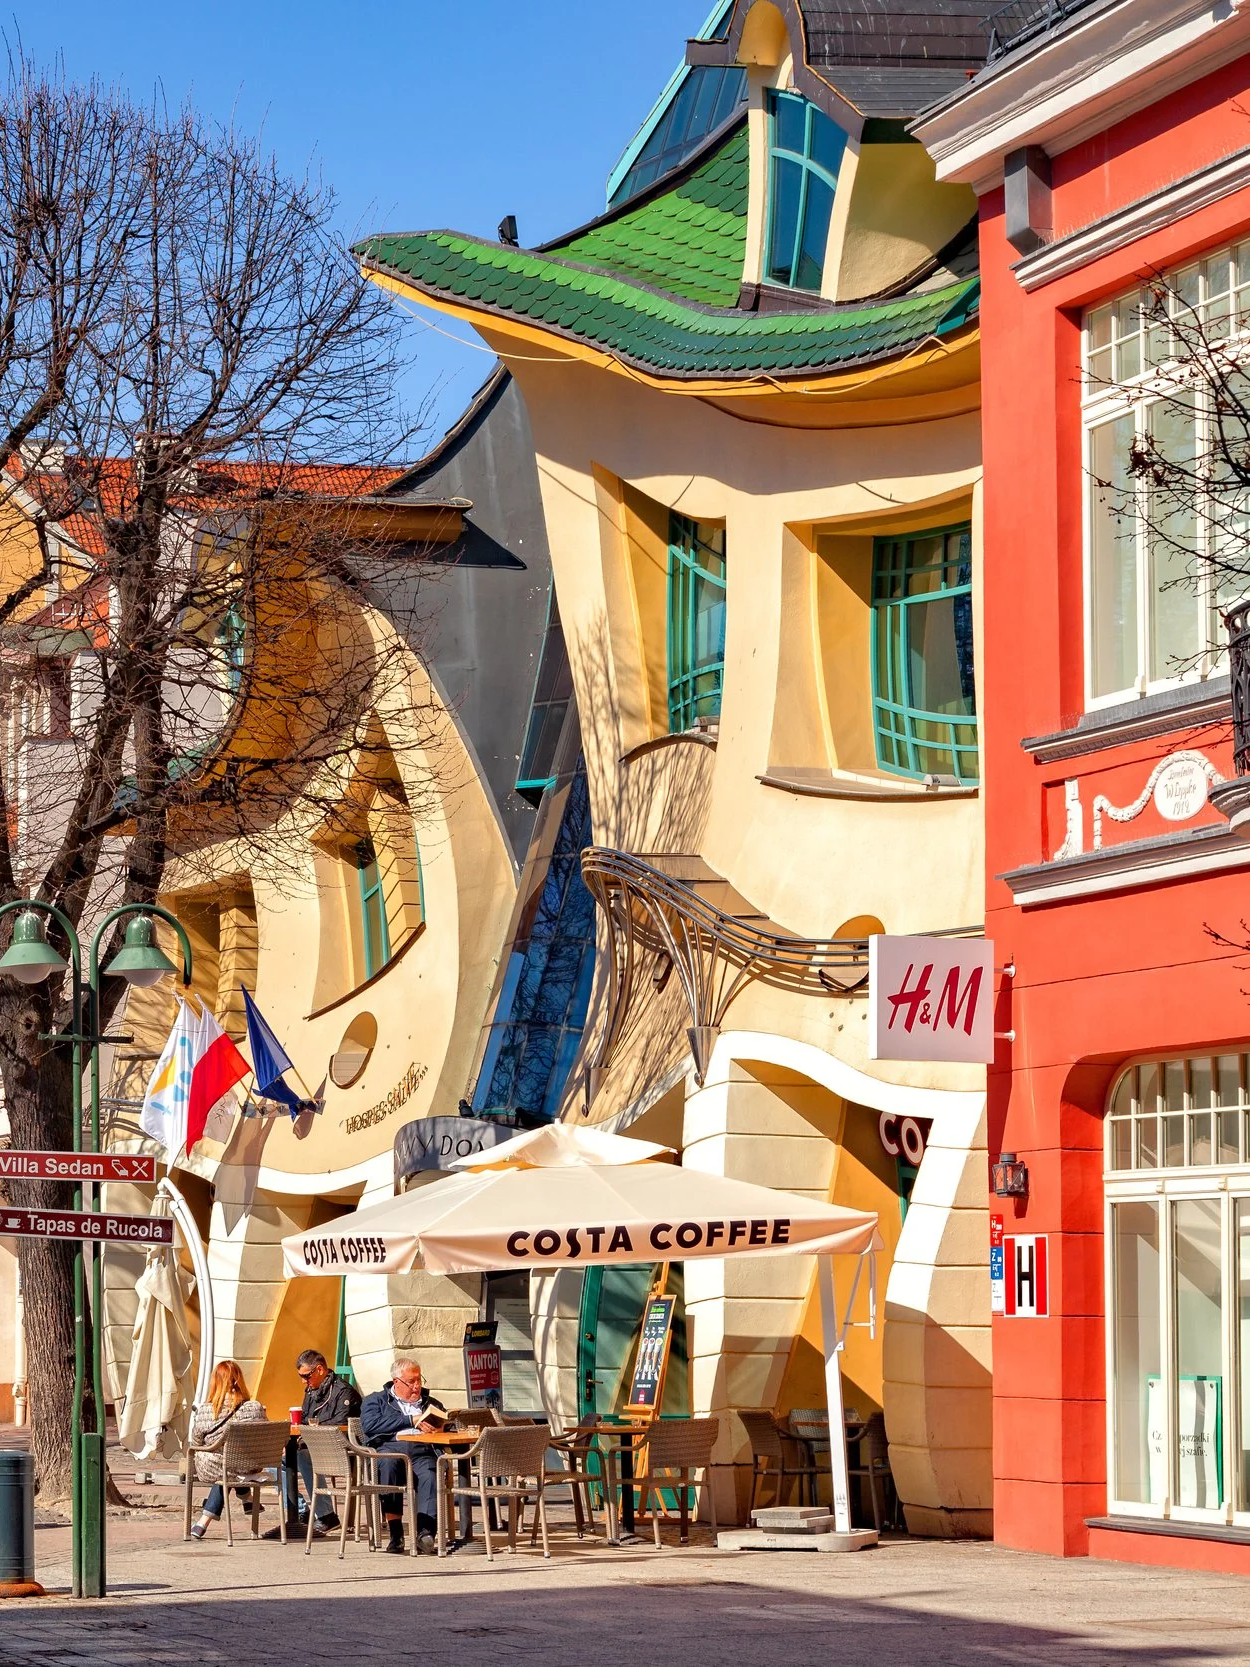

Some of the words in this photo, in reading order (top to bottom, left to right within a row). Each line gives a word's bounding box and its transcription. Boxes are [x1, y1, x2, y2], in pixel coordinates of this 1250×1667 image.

[887, 963, 983, 1036] H&M
[879, 1111, 925, 1164] CO
[45, 1157, 104, 1176] Sedan
[27, 1214, 76, 1235] Tapas
[80, 1218, 100, 1234] de
[106, 1219, 163, 1238] Rucola
[506, 1225, 634, 1258] COSTA
[649, 1218, 790, 1250] COFFEE
[303, 1238, 339, 1267] COSTA
[340, 1237, 387, 1264] COFFEE
[1016, 1245, 1035, 1307] H
[468, 1353, 499, 1371] KANTOR
[1152, 1430, 1163, 1441] Cz
